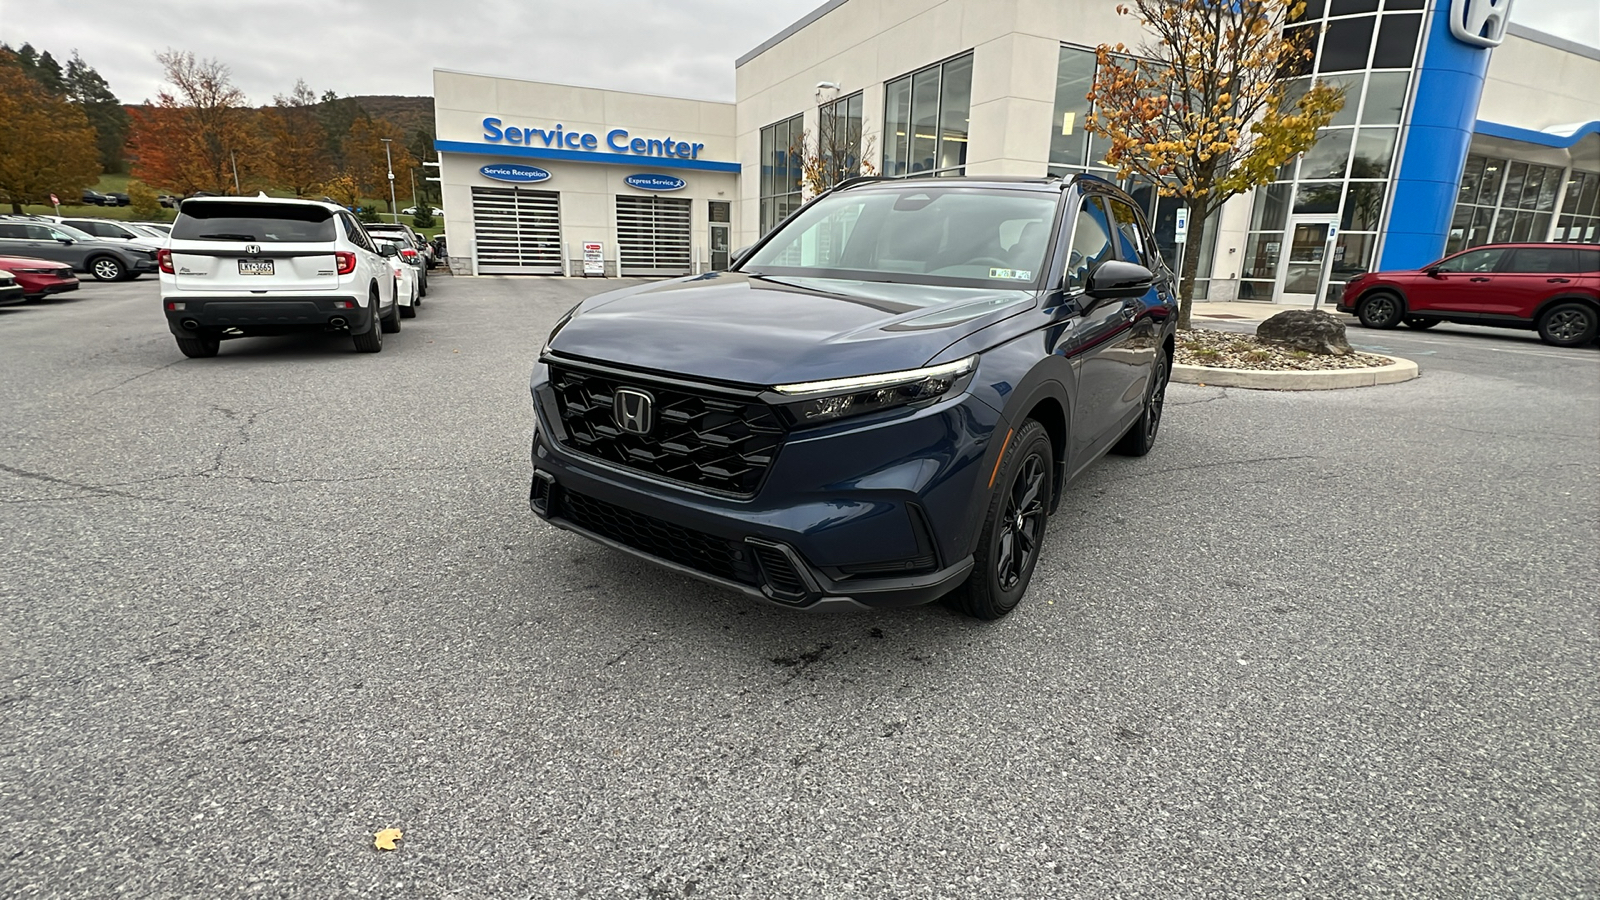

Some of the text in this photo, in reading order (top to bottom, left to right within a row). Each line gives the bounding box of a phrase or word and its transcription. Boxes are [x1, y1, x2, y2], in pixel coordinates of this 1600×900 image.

[482, 117, 705, 160] Service Center
[484, 167, 547, 178] Service Reception
[628, 177, 674, 186] Express Service
